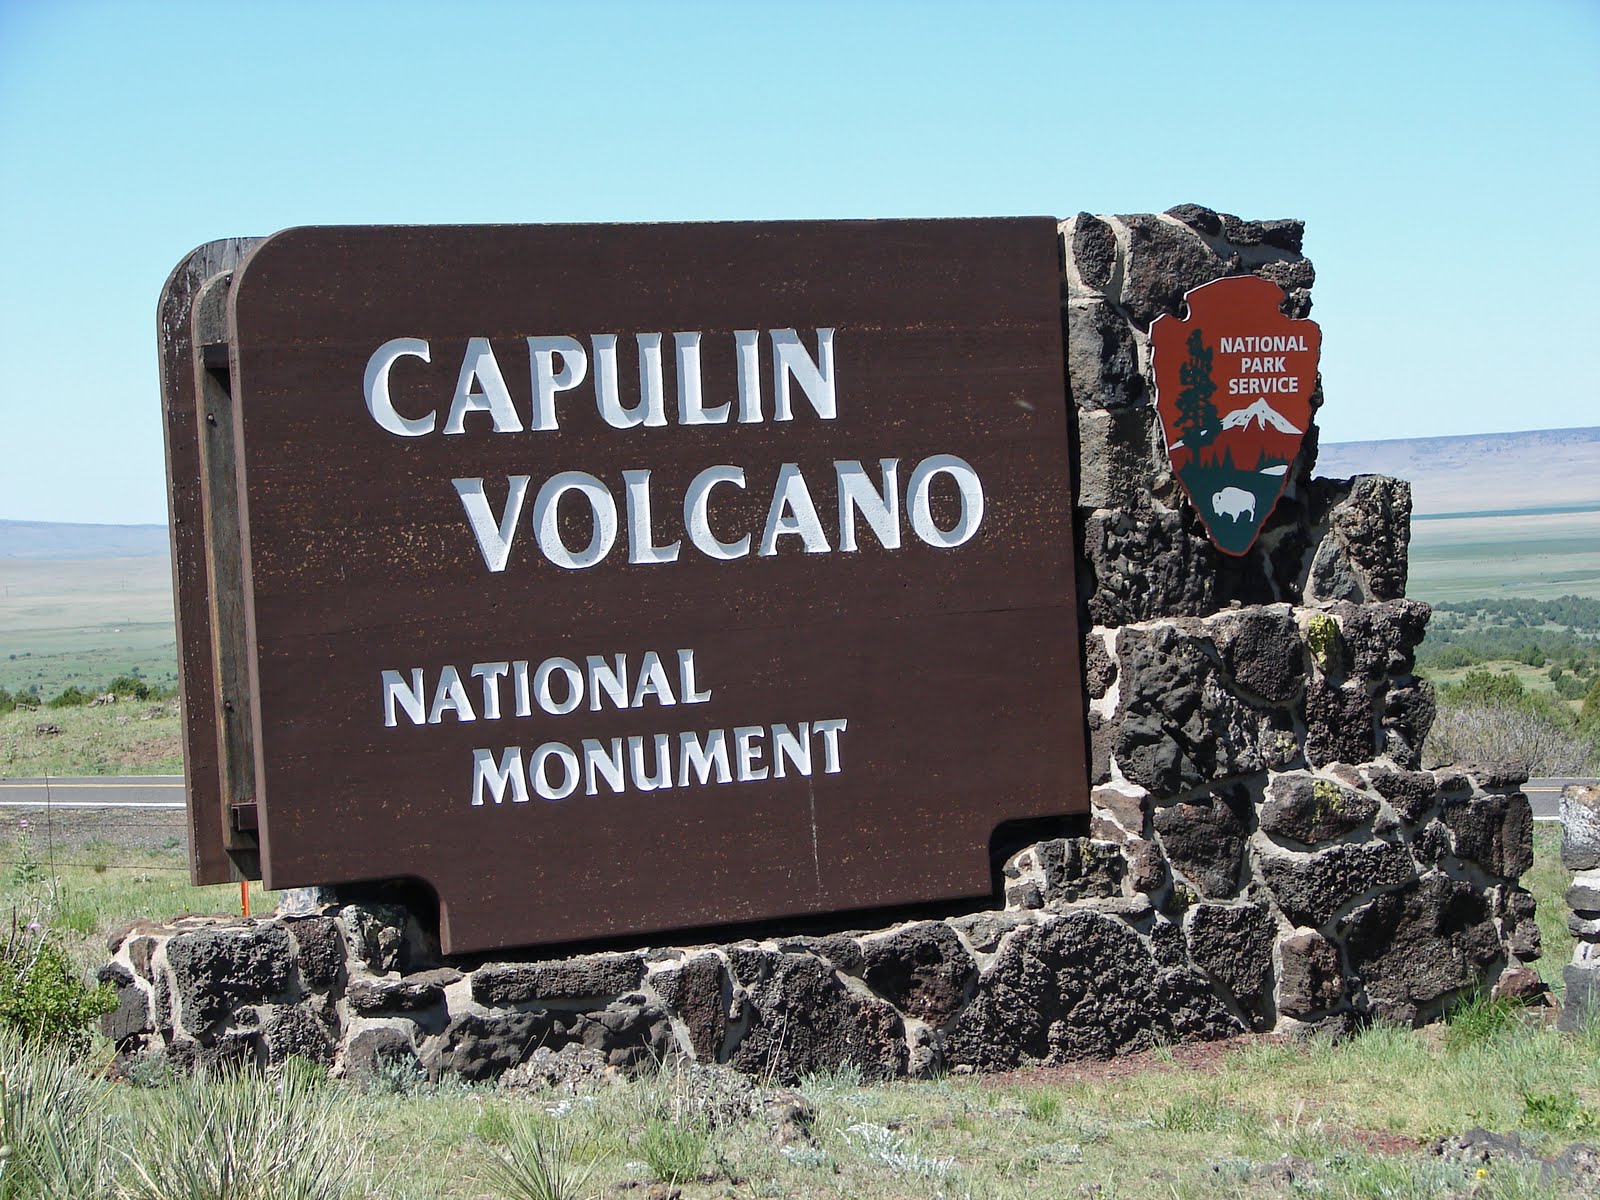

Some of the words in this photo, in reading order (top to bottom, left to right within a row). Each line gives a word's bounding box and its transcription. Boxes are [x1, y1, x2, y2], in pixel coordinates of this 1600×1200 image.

[363, 327, 838, 437] CAPULIN
[1220, 335, 1308, 354] NATIONAL
[1241, 356, 1286, 374] PARK
[1228, 376, 1299, 395] SERVICE
[450, 453, 985, 573] VOLCANO
[381, 648, 712, 728] NATIONAL
[471, 717, 848, 806] MONUMENT
